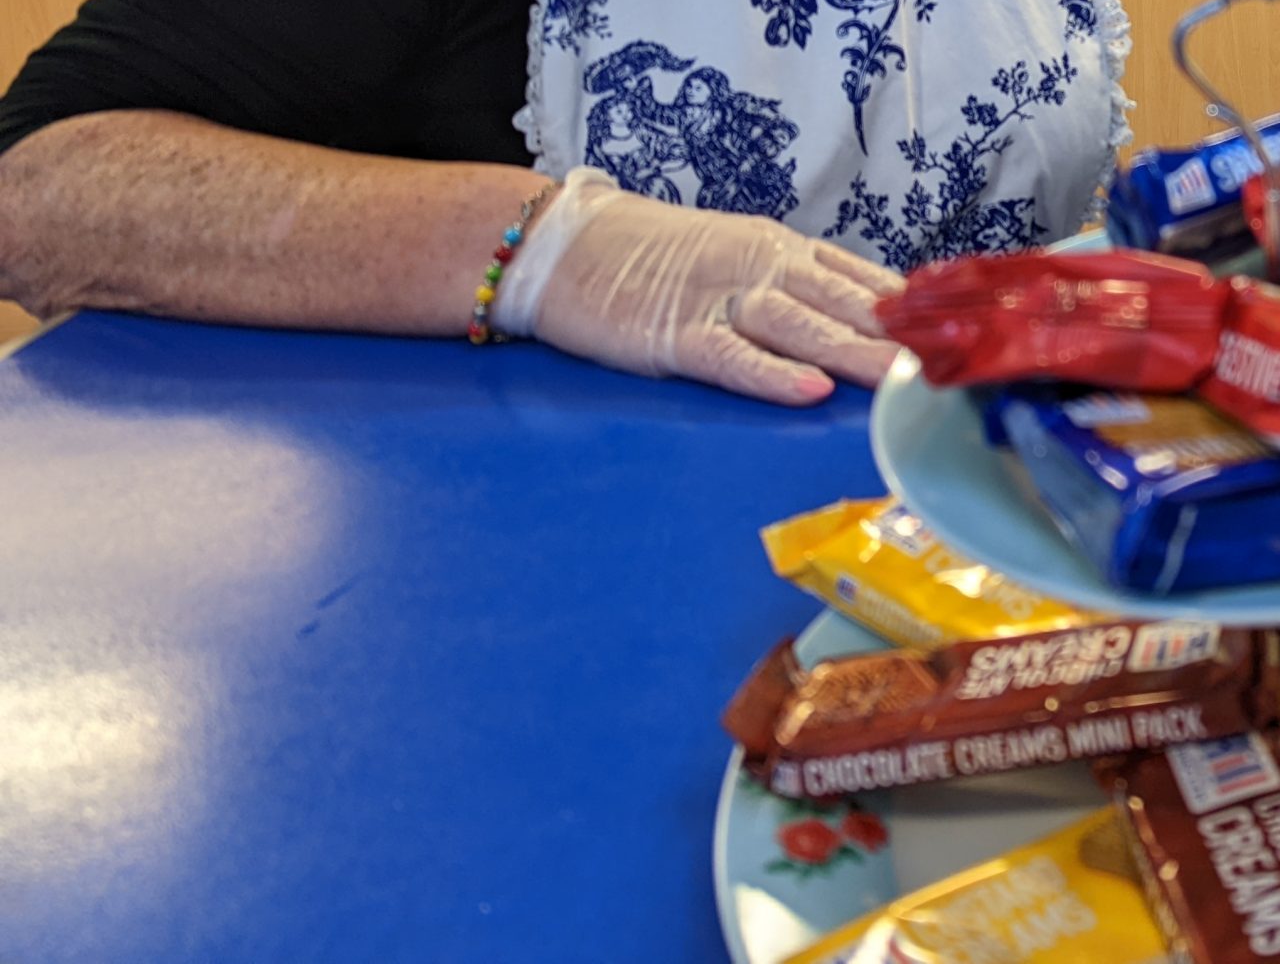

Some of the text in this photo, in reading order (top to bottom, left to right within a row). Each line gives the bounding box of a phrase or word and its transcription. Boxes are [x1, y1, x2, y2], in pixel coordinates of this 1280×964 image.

[971, 624, 1132, 673] CREAMS
[802, 741, 954, 796] CHOCOLATE
[954, 727, 1067, 776] CREAMS
[1067, 714, 1131, 755] MINI
[1132, 704, 1207, 747] PACK
